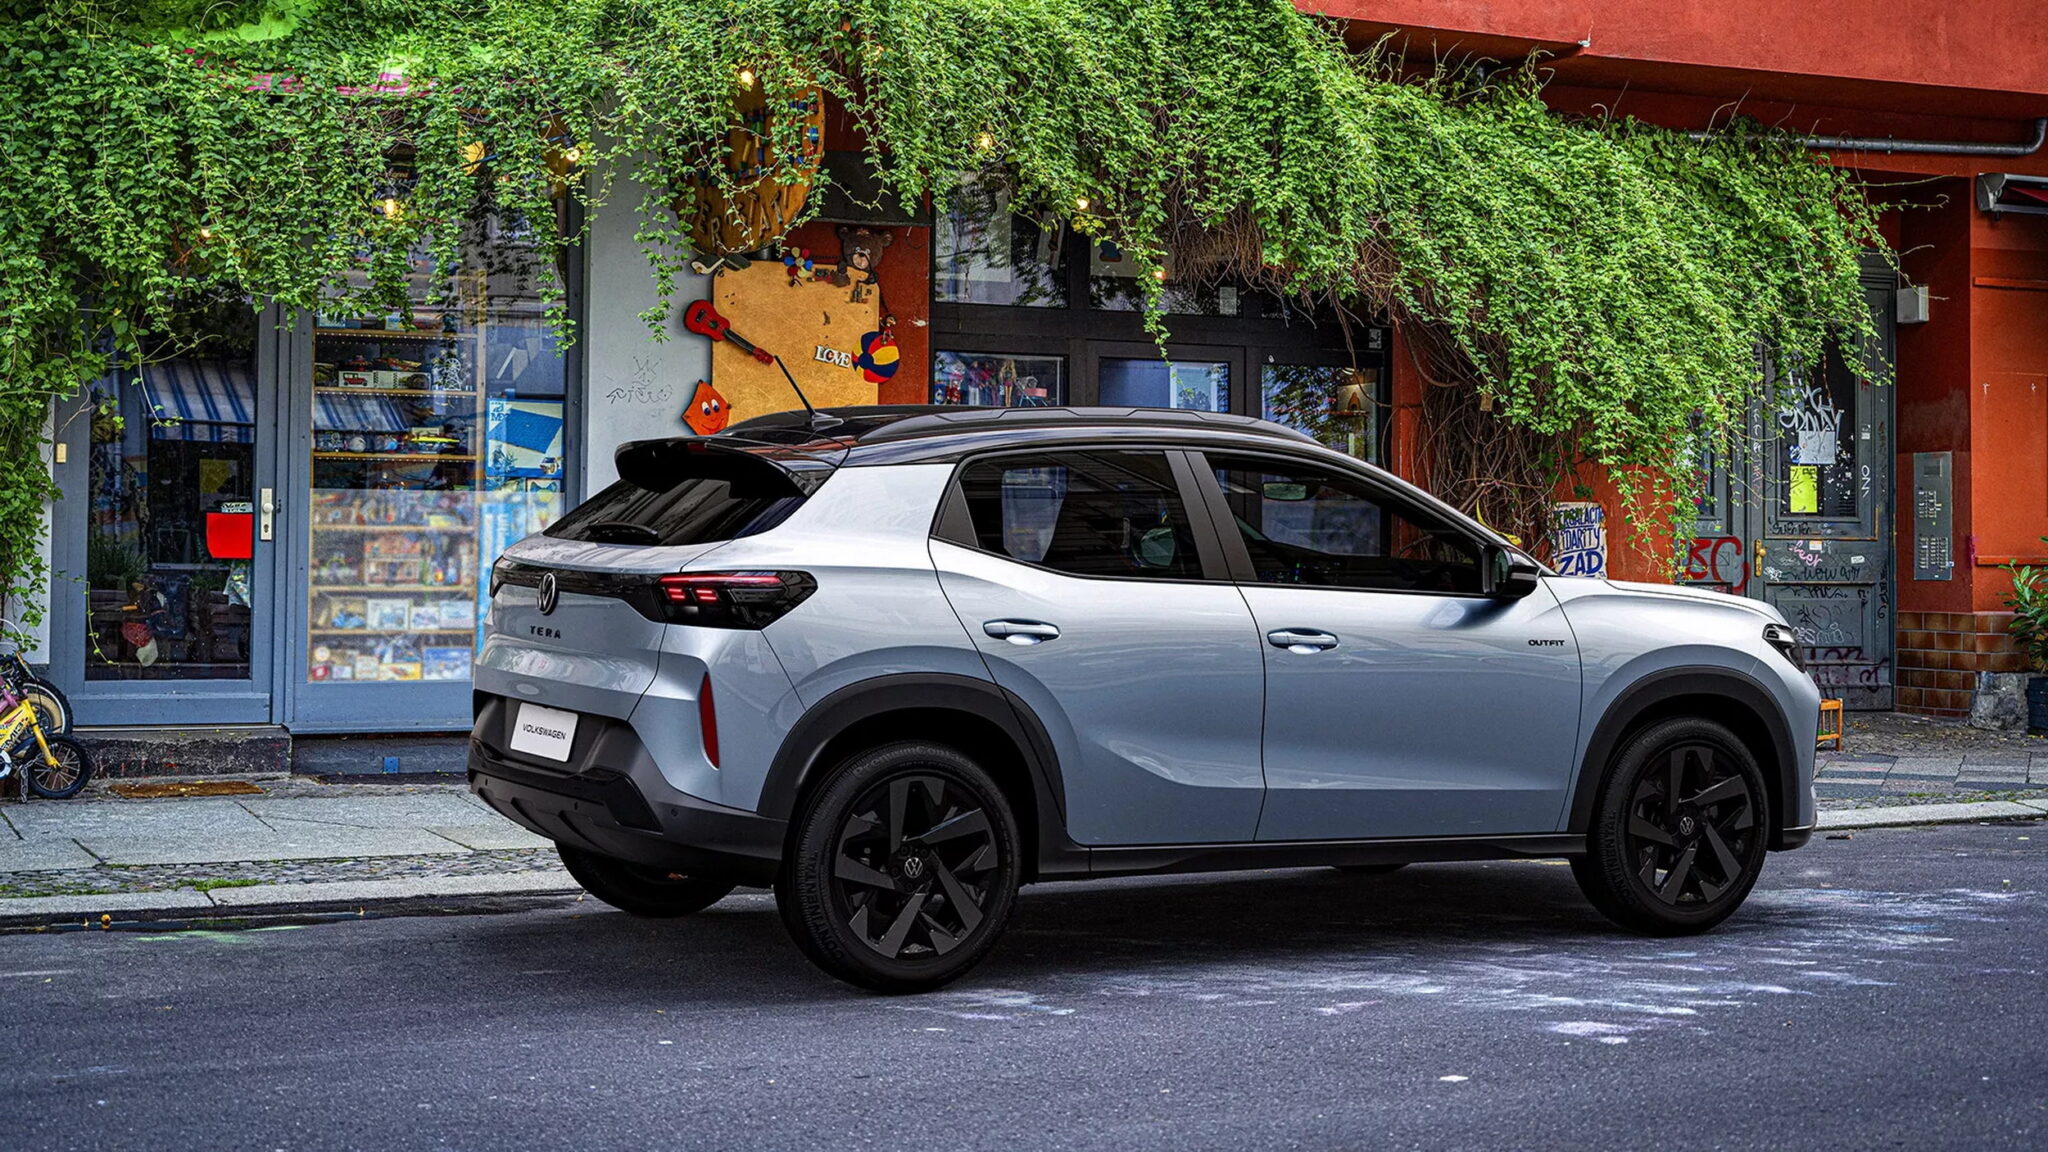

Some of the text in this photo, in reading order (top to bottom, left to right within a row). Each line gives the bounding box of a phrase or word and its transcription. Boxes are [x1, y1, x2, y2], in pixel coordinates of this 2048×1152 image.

[815, 345, 851, 369] LOVE
[1559, 550, 1604, 577] ZAD
[530, 625, 562, 640] TERA
[1528, 639, 1565, 647] OUTFIT
[523, 723, 567, 741] VOLKSWAGEN
